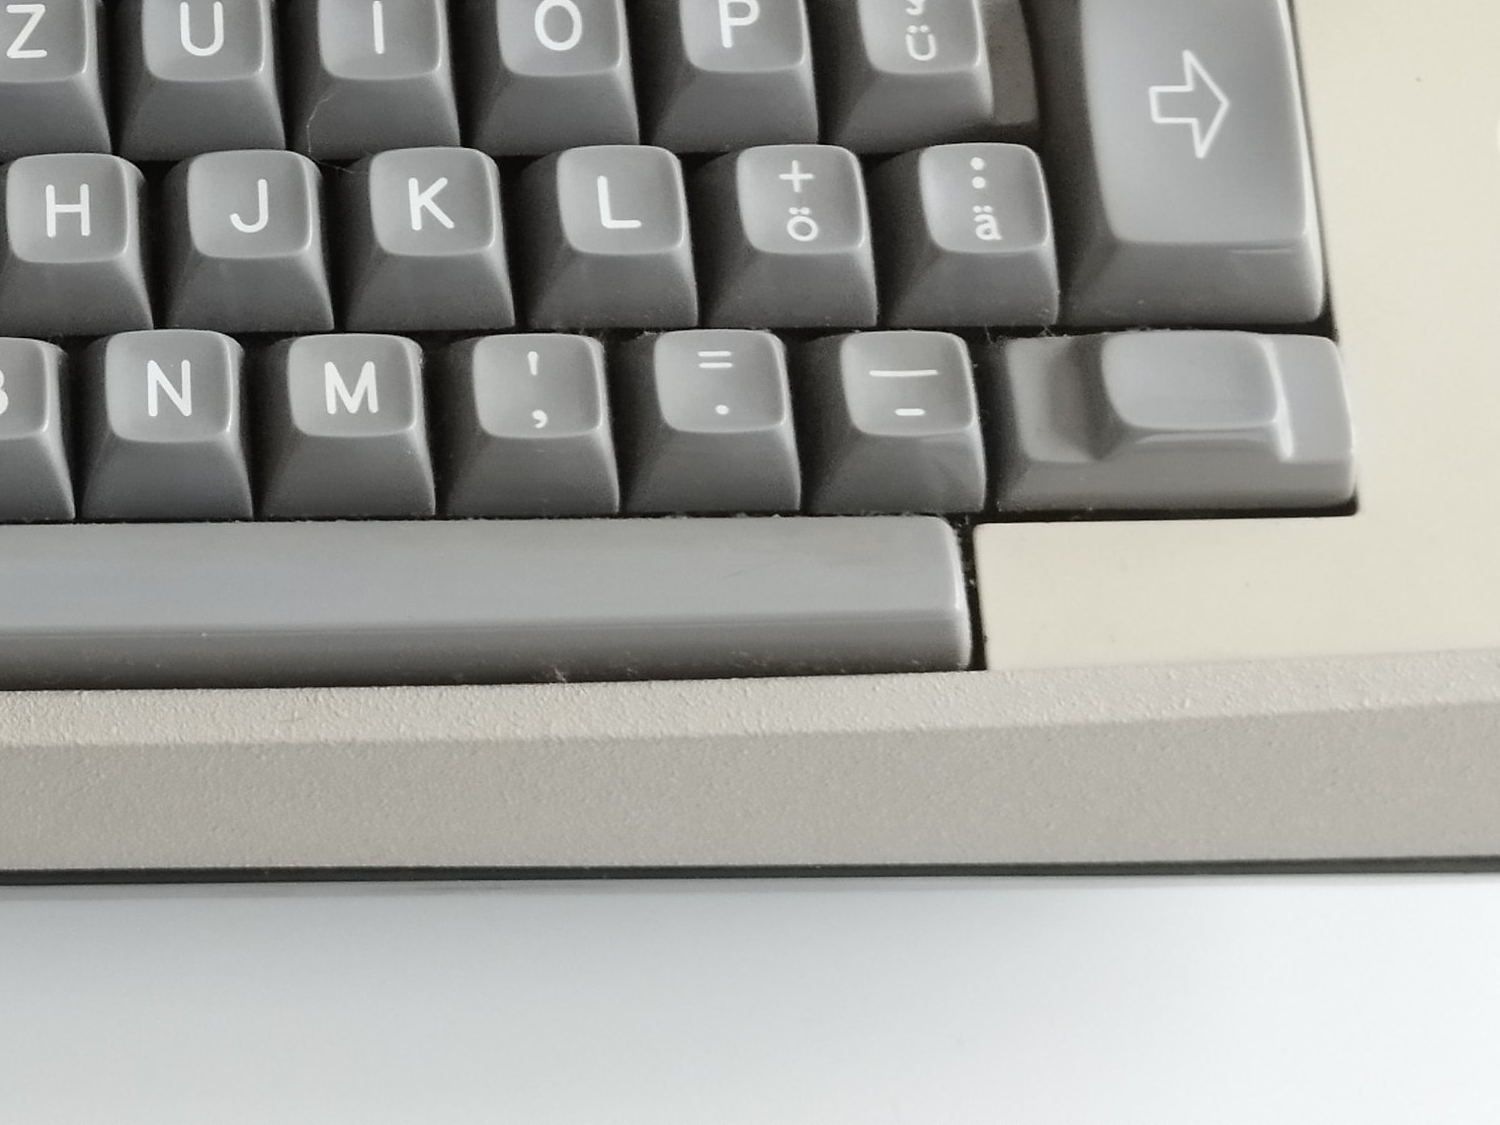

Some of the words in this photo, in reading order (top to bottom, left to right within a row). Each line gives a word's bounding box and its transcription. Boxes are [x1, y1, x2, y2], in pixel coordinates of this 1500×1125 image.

[5, 3, 48, 59] Z
[179, 0, 225, 57] U
[372, 0, 385, 55] I
[45, 182, 91, 239] H
[229, 178, 269, 234] J
[408, 176, 455, 232] K
[596, 175, 642, 230] L
[786, 206, 819, 242] ö
[972, 205, 1003, 241] ä
[146, 359, 193, 418] N
[324, 360, 379, 415] M
[531, 409, 549, 429] ,
